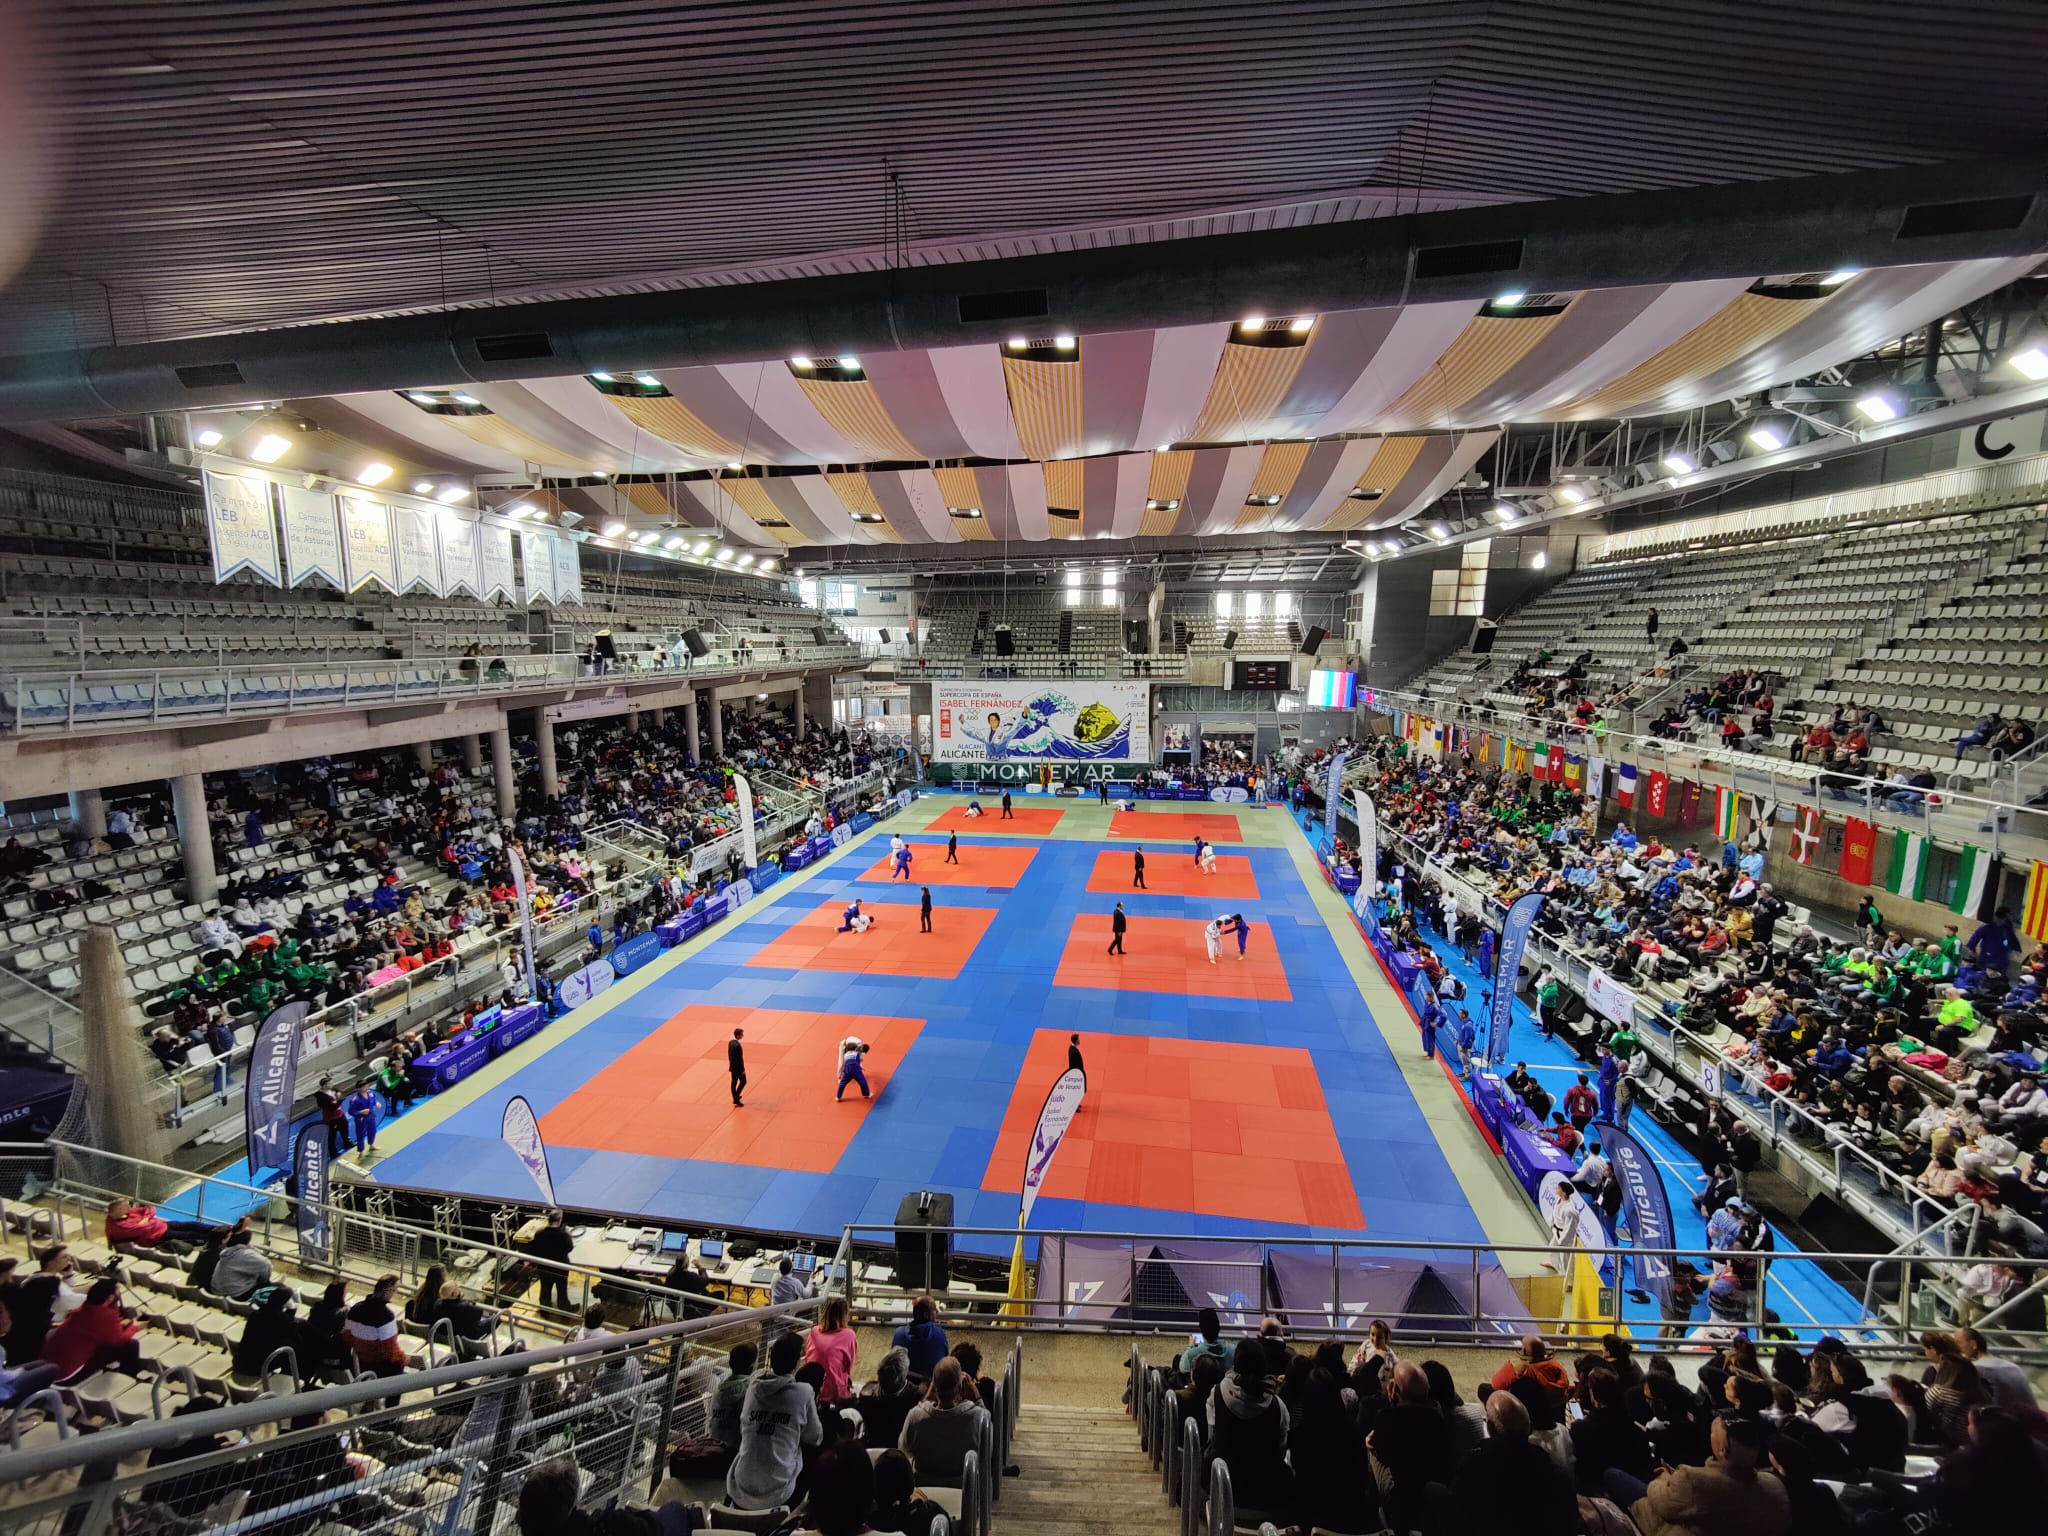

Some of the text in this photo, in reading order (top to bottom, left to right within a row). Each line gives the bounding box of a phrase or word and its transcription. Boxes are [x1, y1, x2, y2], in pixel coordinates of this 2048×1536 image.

[215, 507, 239, 522] LEB
[250, 528, 270, 540] ACB
[349, 527, 367, 540] LEB
[688, 601, 697, 616] A
[939, 700, 968, 708] ISABEL
[941, 750, 985, 759] ALICANTE
[628, 937, 657, 956] MONTEMAR
[1493, 939, 1515, 1040] MONTEMAR
[311, 1035, 319, 1049] 1
[261, 1021, 292, 1105] Alicante
[1704, 1068, 1714, 1092] 8
[1049, 1094, 1065, 1105] judo
